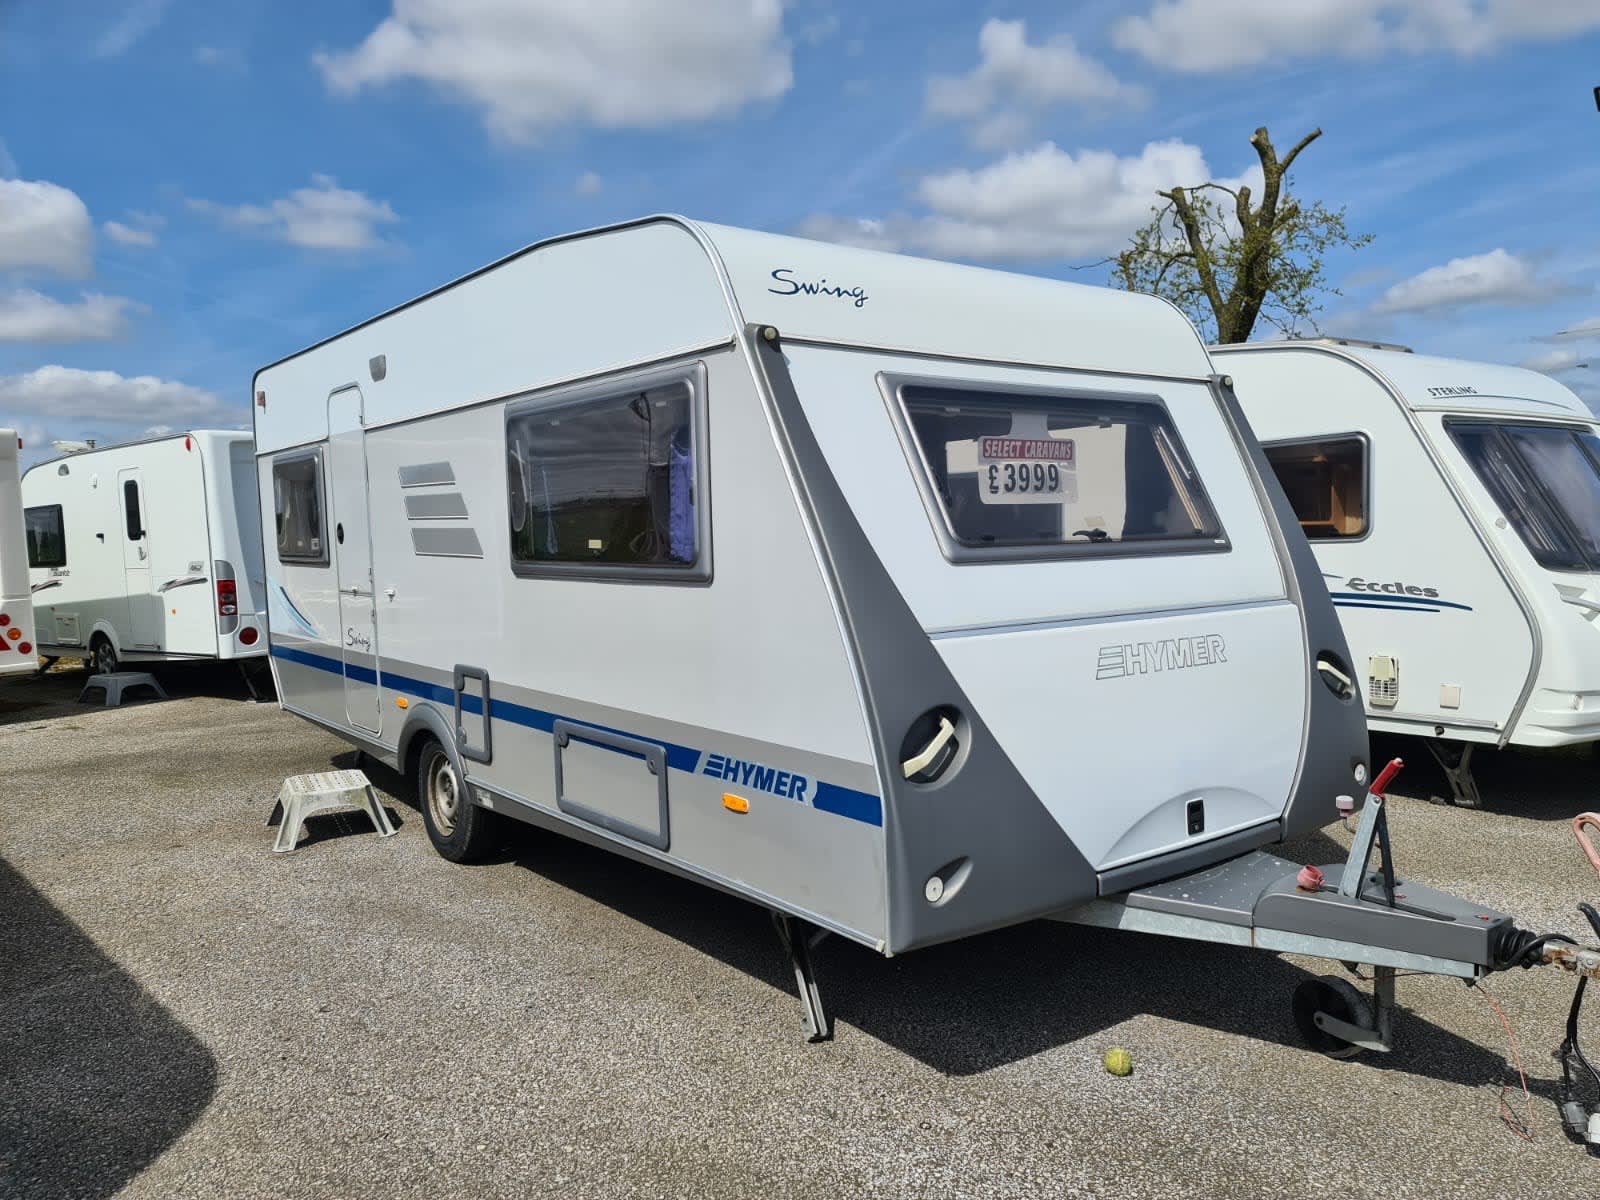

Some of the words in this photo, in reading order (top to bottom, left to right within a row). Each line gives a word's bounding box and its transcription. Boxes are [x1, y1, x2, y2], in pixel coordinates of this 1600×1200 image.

[767, 268, 869, 308] Swing
[1426, 386, 1478, 397] STERLING
[984, 440, 1022, 457] SELECT
[1024, 441, 1072, 459] CARAVANS
[988, 463, 1059, 494] £3999
[1345, 577, 1440, 598] Eccles
[722, 756, 808, 802] HYMER
